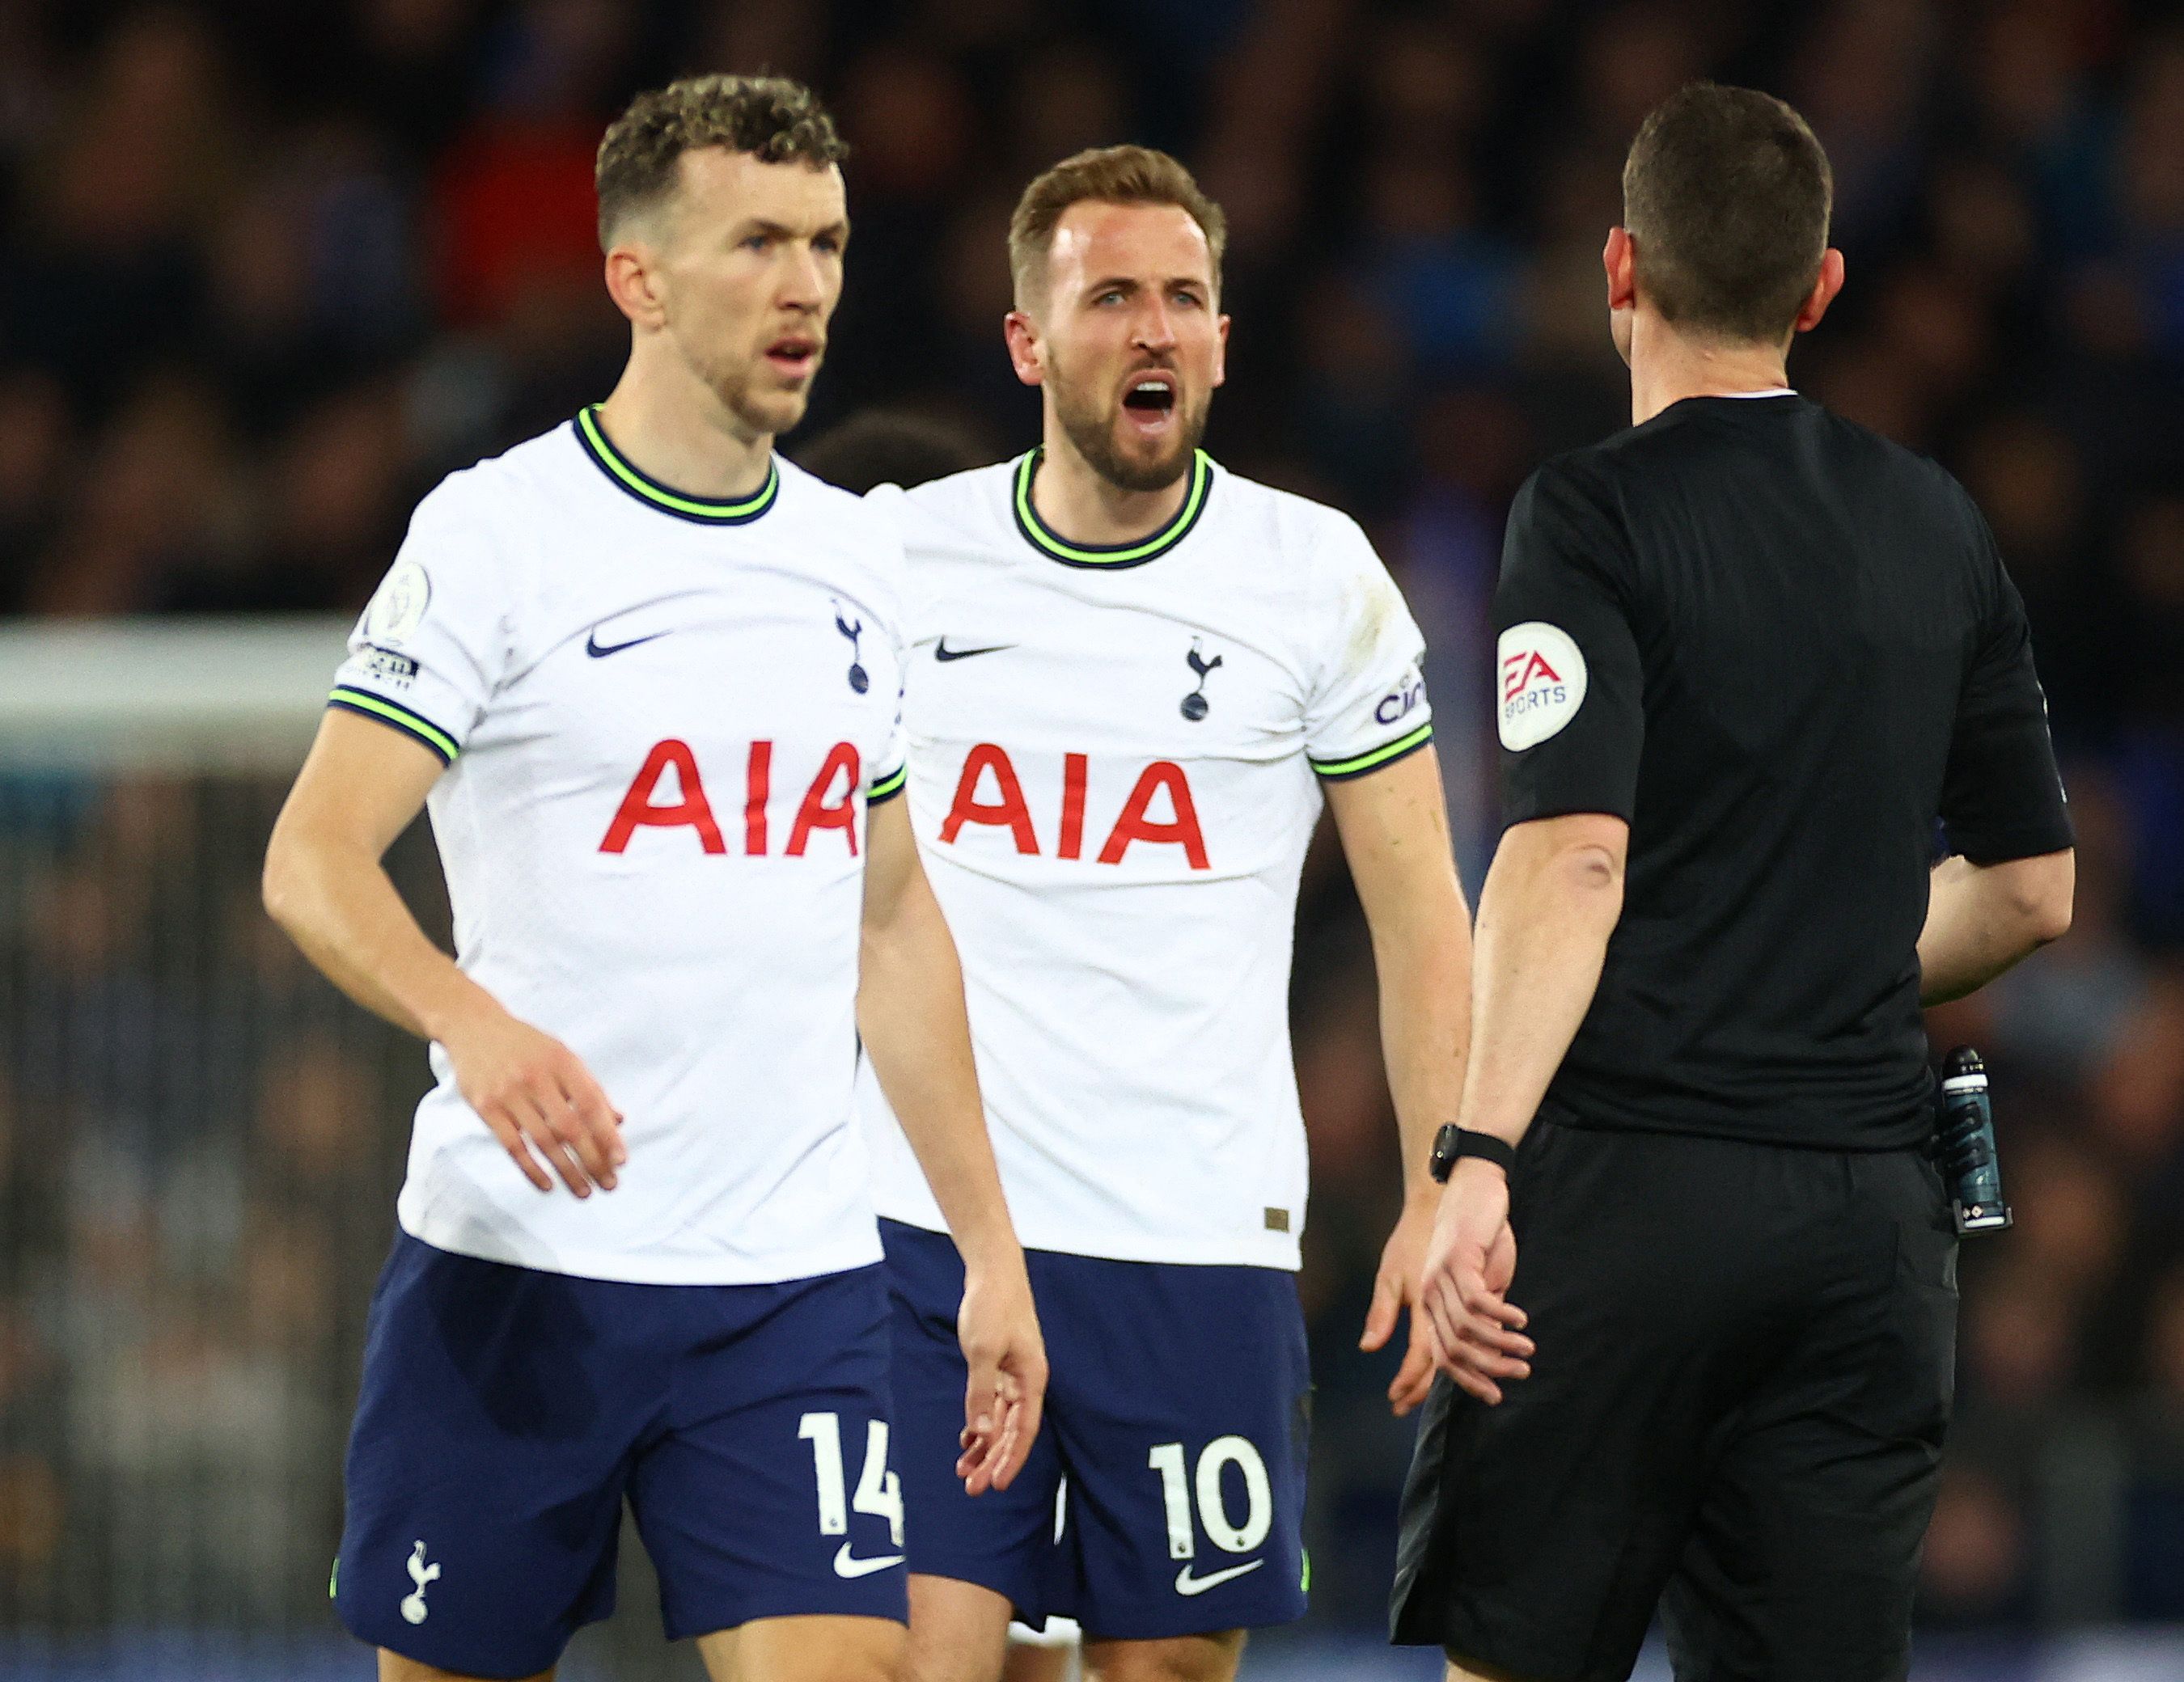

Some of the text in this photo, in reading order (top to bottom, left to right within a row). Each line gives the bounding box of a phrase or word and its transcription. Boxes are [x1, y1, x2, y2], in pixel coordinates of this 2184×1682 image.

[1503, 650, 1561, 702] EA
[599, 738, 861, 857] AIA
[938, 742, 1211, 871] AIA
[798, 1412, 905, 1547] 14
[1149, 1435, 1272, 1559] 10
